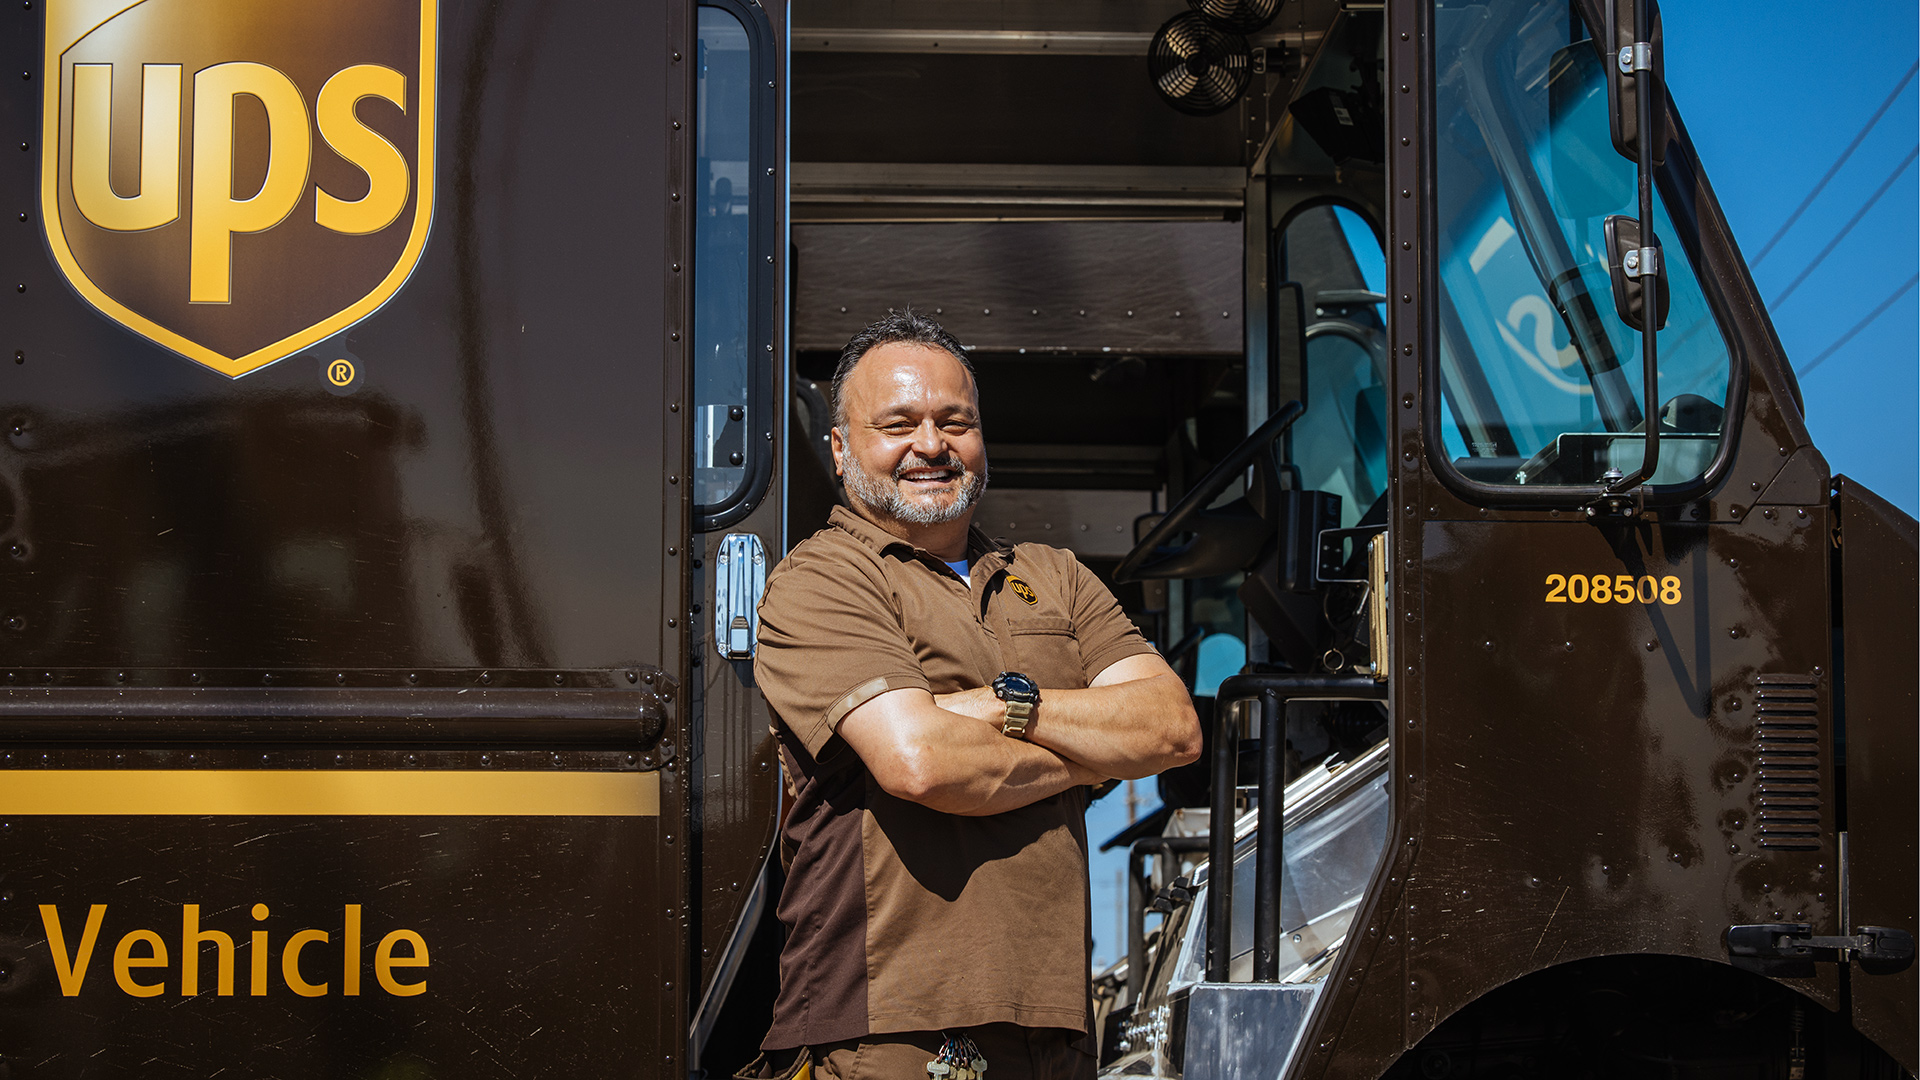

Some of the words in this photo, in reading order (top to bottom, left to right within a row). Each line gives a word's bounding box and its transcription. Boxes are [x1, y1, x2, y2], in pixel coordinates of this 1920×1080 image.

[71, 61, 410, 304] ups
[1011, 582, 1034, 599] ups
[1545, 573, 1682, 605] 208508
[38, 903, 430, 998] Vehicle
